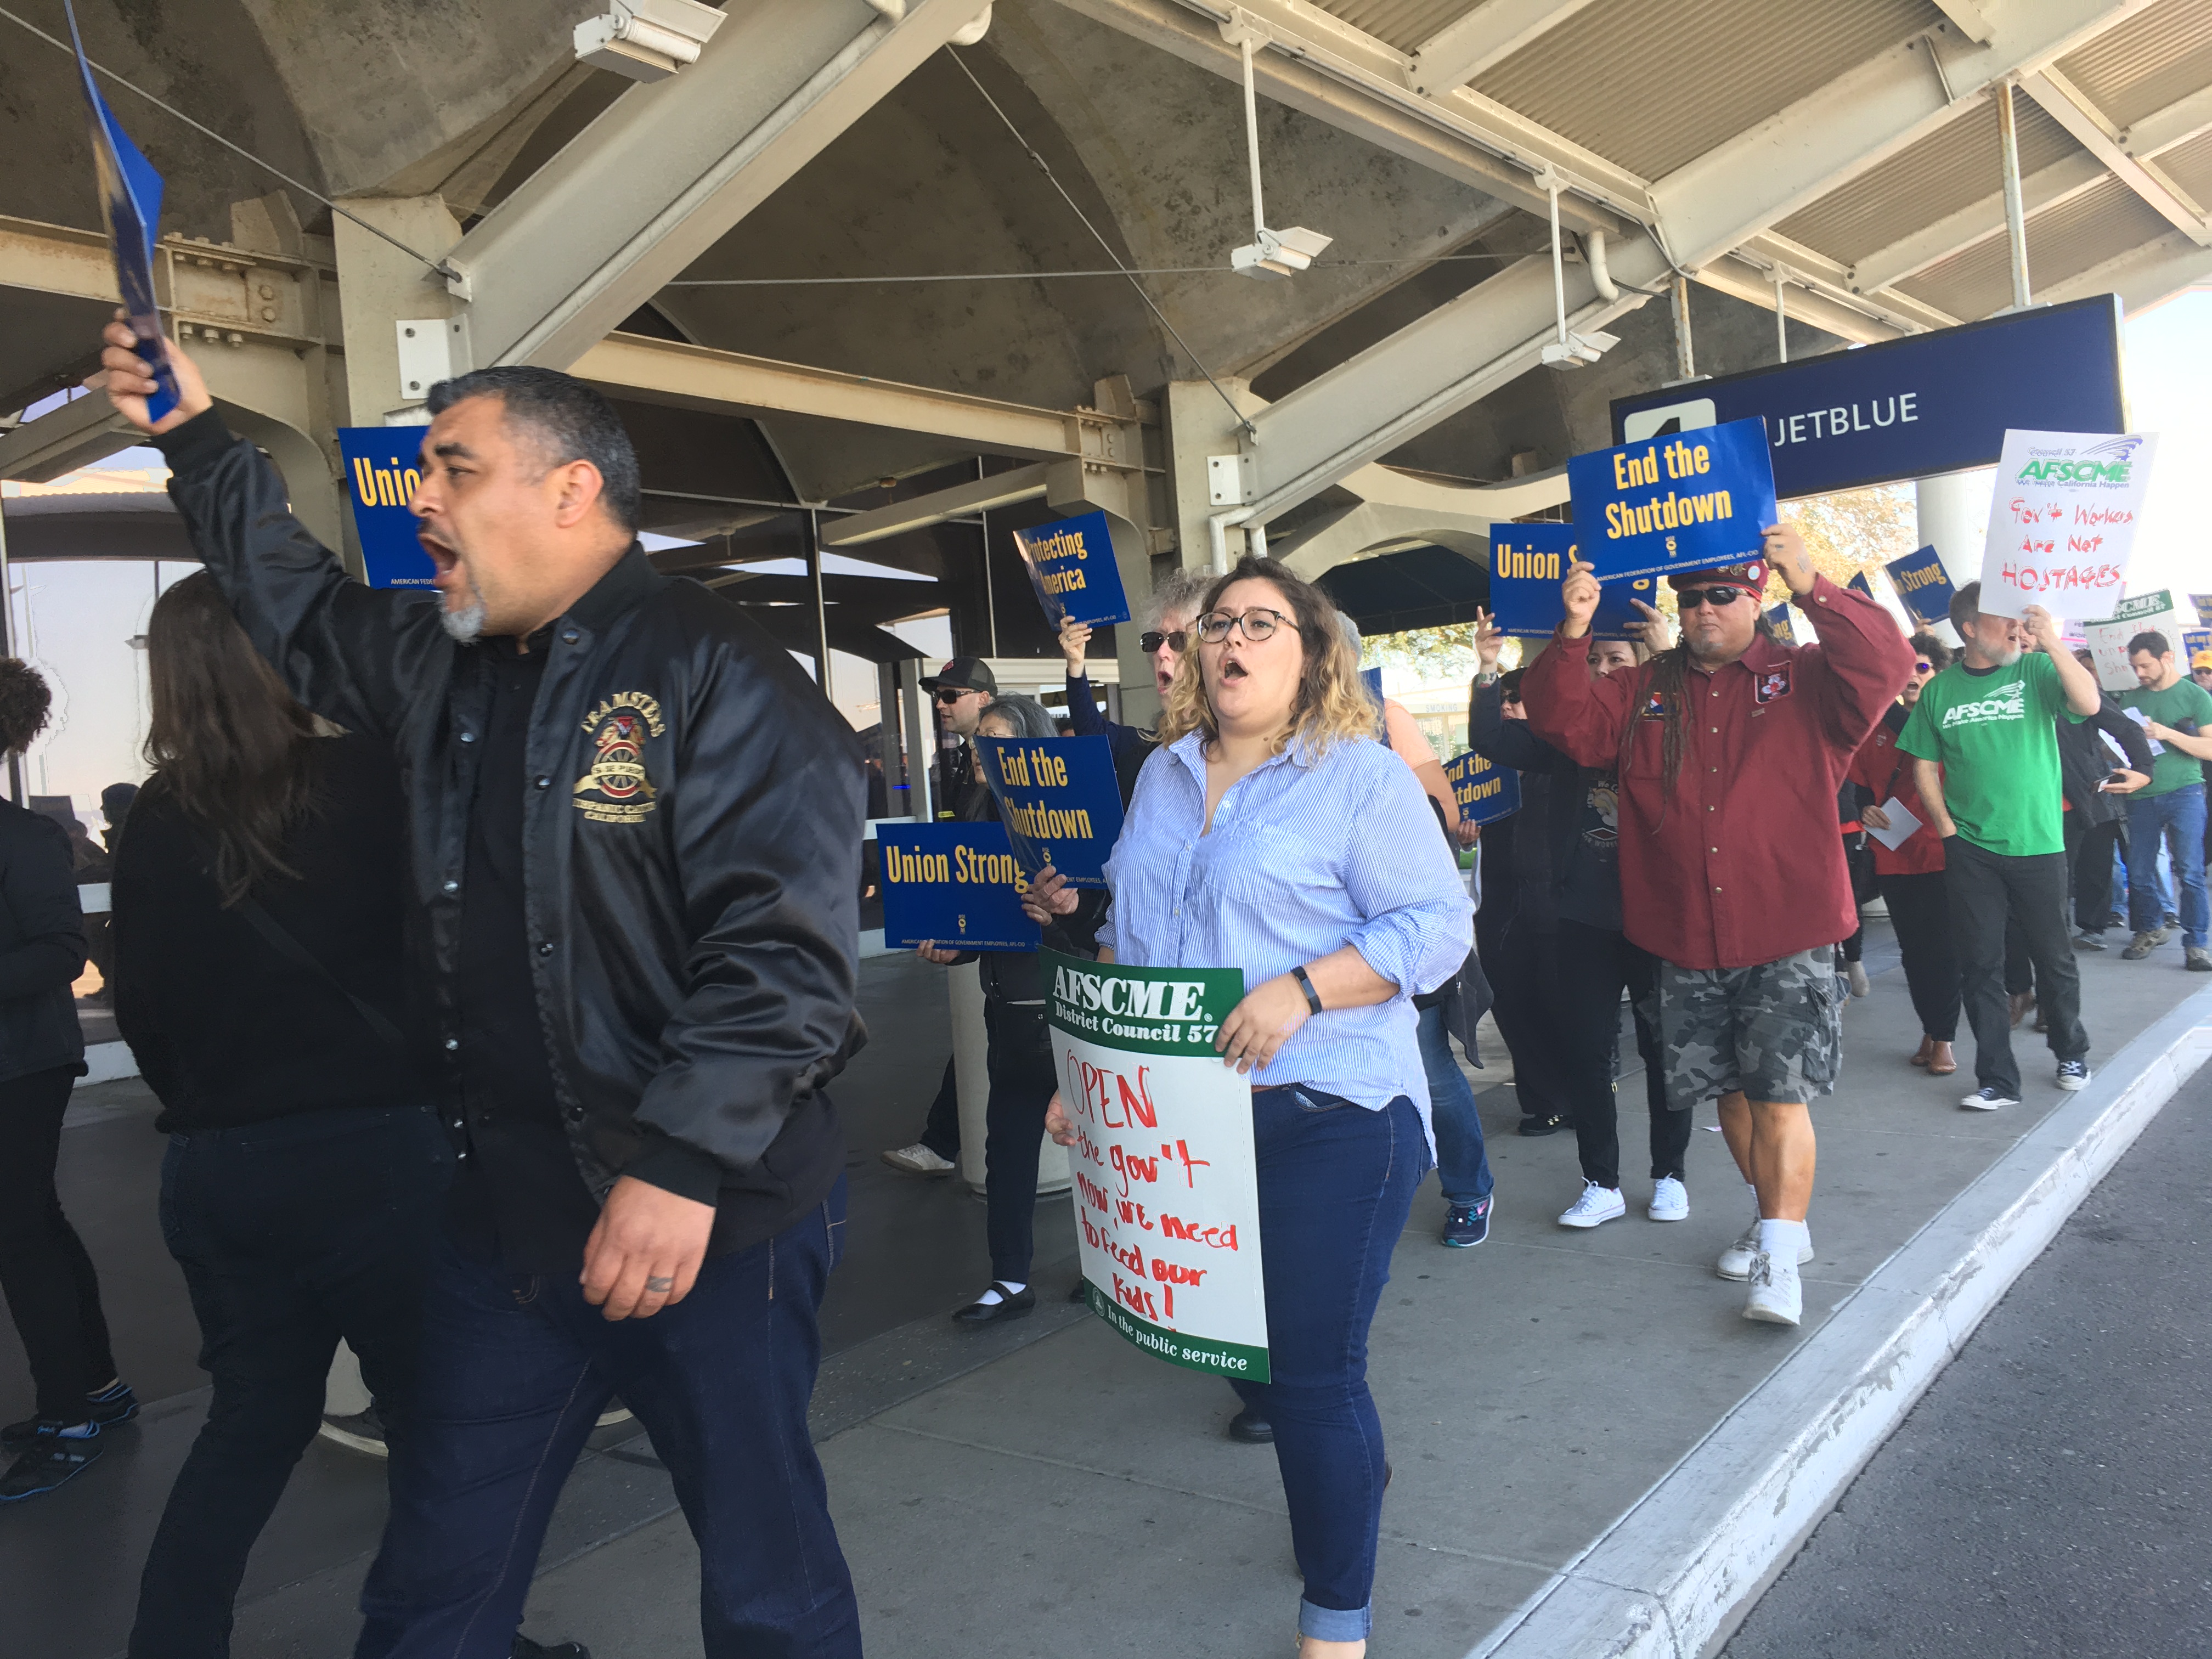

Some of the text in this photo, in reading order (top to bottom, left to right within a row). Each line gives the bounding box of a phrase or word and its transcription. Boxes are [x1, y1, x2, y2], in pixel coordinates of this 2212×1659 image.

[1774, 393, 1919, 447] JETBLUE
[1613, 441, 1710, 490] End the
[2028, 447, 2062, 456] Council
[353, 457, 423, 507] Unio
[2015, 458, 2133, 483] AFSCME
[2100, 481, 2129, 489] Happen
[1605, 490, 1733, 539] Shutdown
[1025, 529, 1088, 562] Protecting
[1497, 544, 1559, 579] Union
[1039, 565, 1086, 595] America
[1597, 573, 1623, 582] AMERICAN
[1624, 567, 1656, 577] FEDERATION
[1664, 559, 1701, 571] GOVERNMENT
[1901, 562, 1946, 591] Strong
[2000, 559, 2121, 591] HOSTAGES
[2114, 594, 2160, 614] SCME
[1426, 703, 1458, 713] SMOKING
[1943, 698, 2025, 724] AFSCME
[996, 747, 1068, 787] End the
[1454, 777, 1501, 805] tdown
[1004, 796, 1093, 839] Shutdown
[885, 845, 1029, 893] Union Strong
[1055, 1001, 1218, 1042] District Council 57
[1067, 1049, 1158, 1128] OPEN
[1077, 1125, 1104, 1166] the
[1081, 1205, 1100, 1249] to
[1152, 1259, 1207, 1287] our
[1160, 1213, 1239, 1251] need
[1107, 1305, 1247, 1370] In the public service
